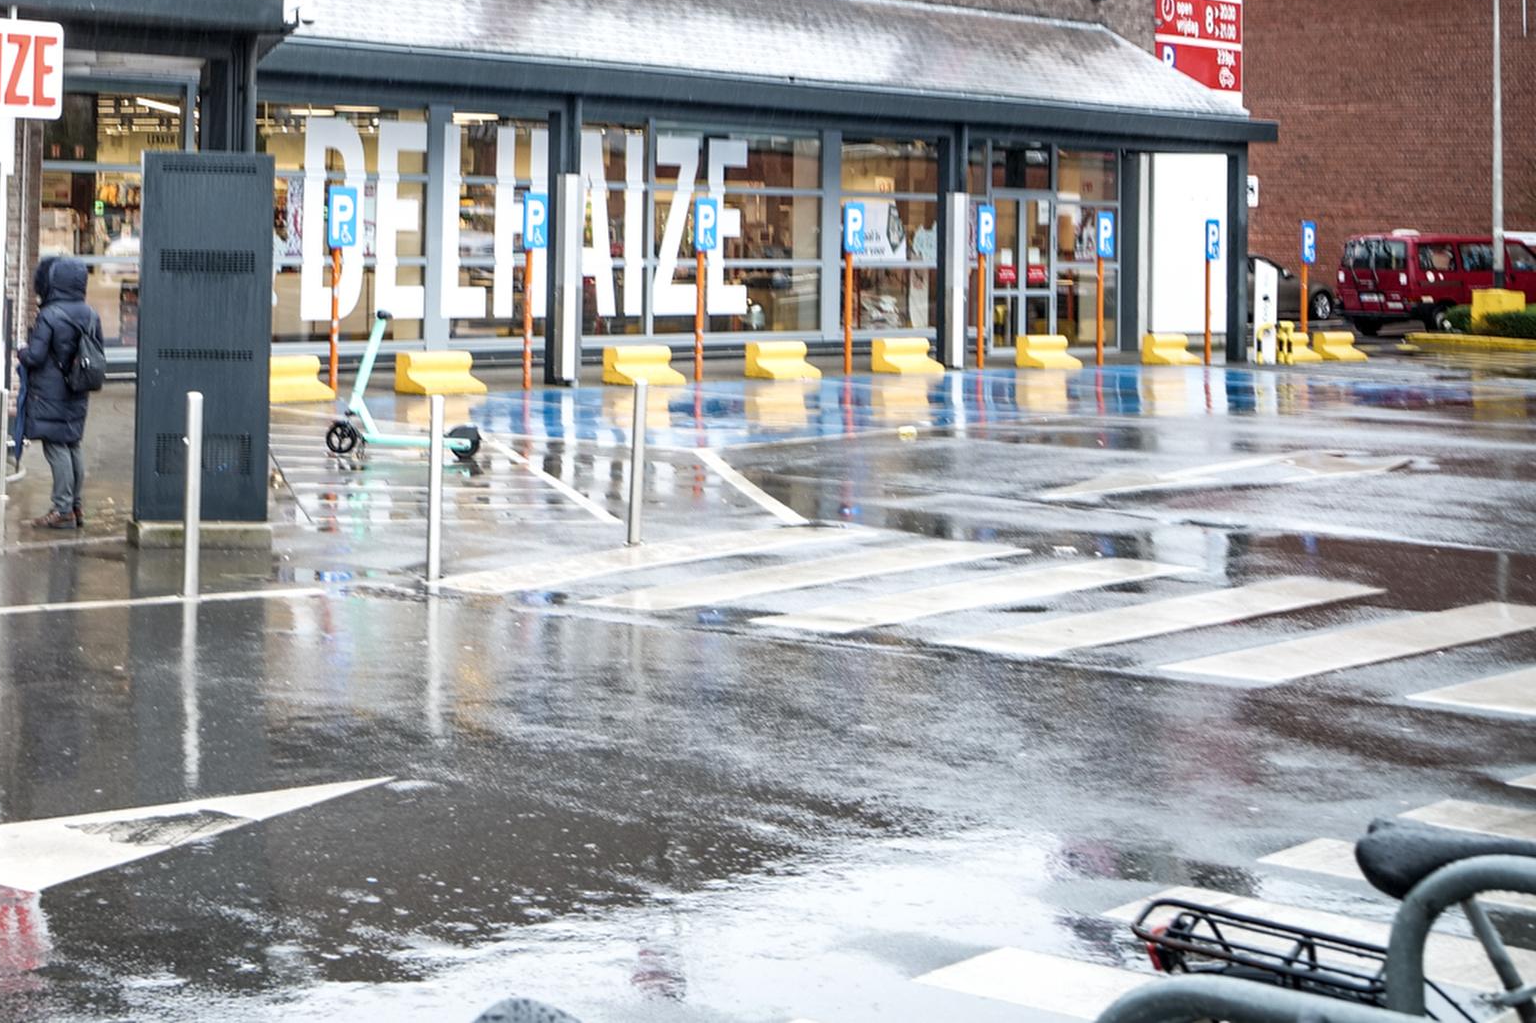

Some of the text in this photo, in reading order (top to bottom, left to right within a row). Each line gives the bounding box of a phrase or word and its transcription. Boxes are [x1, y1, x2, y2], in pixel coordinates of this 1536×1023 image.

[1176, 0, 1193, 18] open
[1205, 4, 1214, 35] 8
[332, 193, 355, 240] P
[526, 198, 545, 242] P
[698, 205, 716, 244] P
[848, 209, 862, 246] P
[980, 212, 993, 247] P
[1099, 218, 1112, 251] P
[1208, 224, 1218, 254] P
[1304, 233, 1314, 261] P
